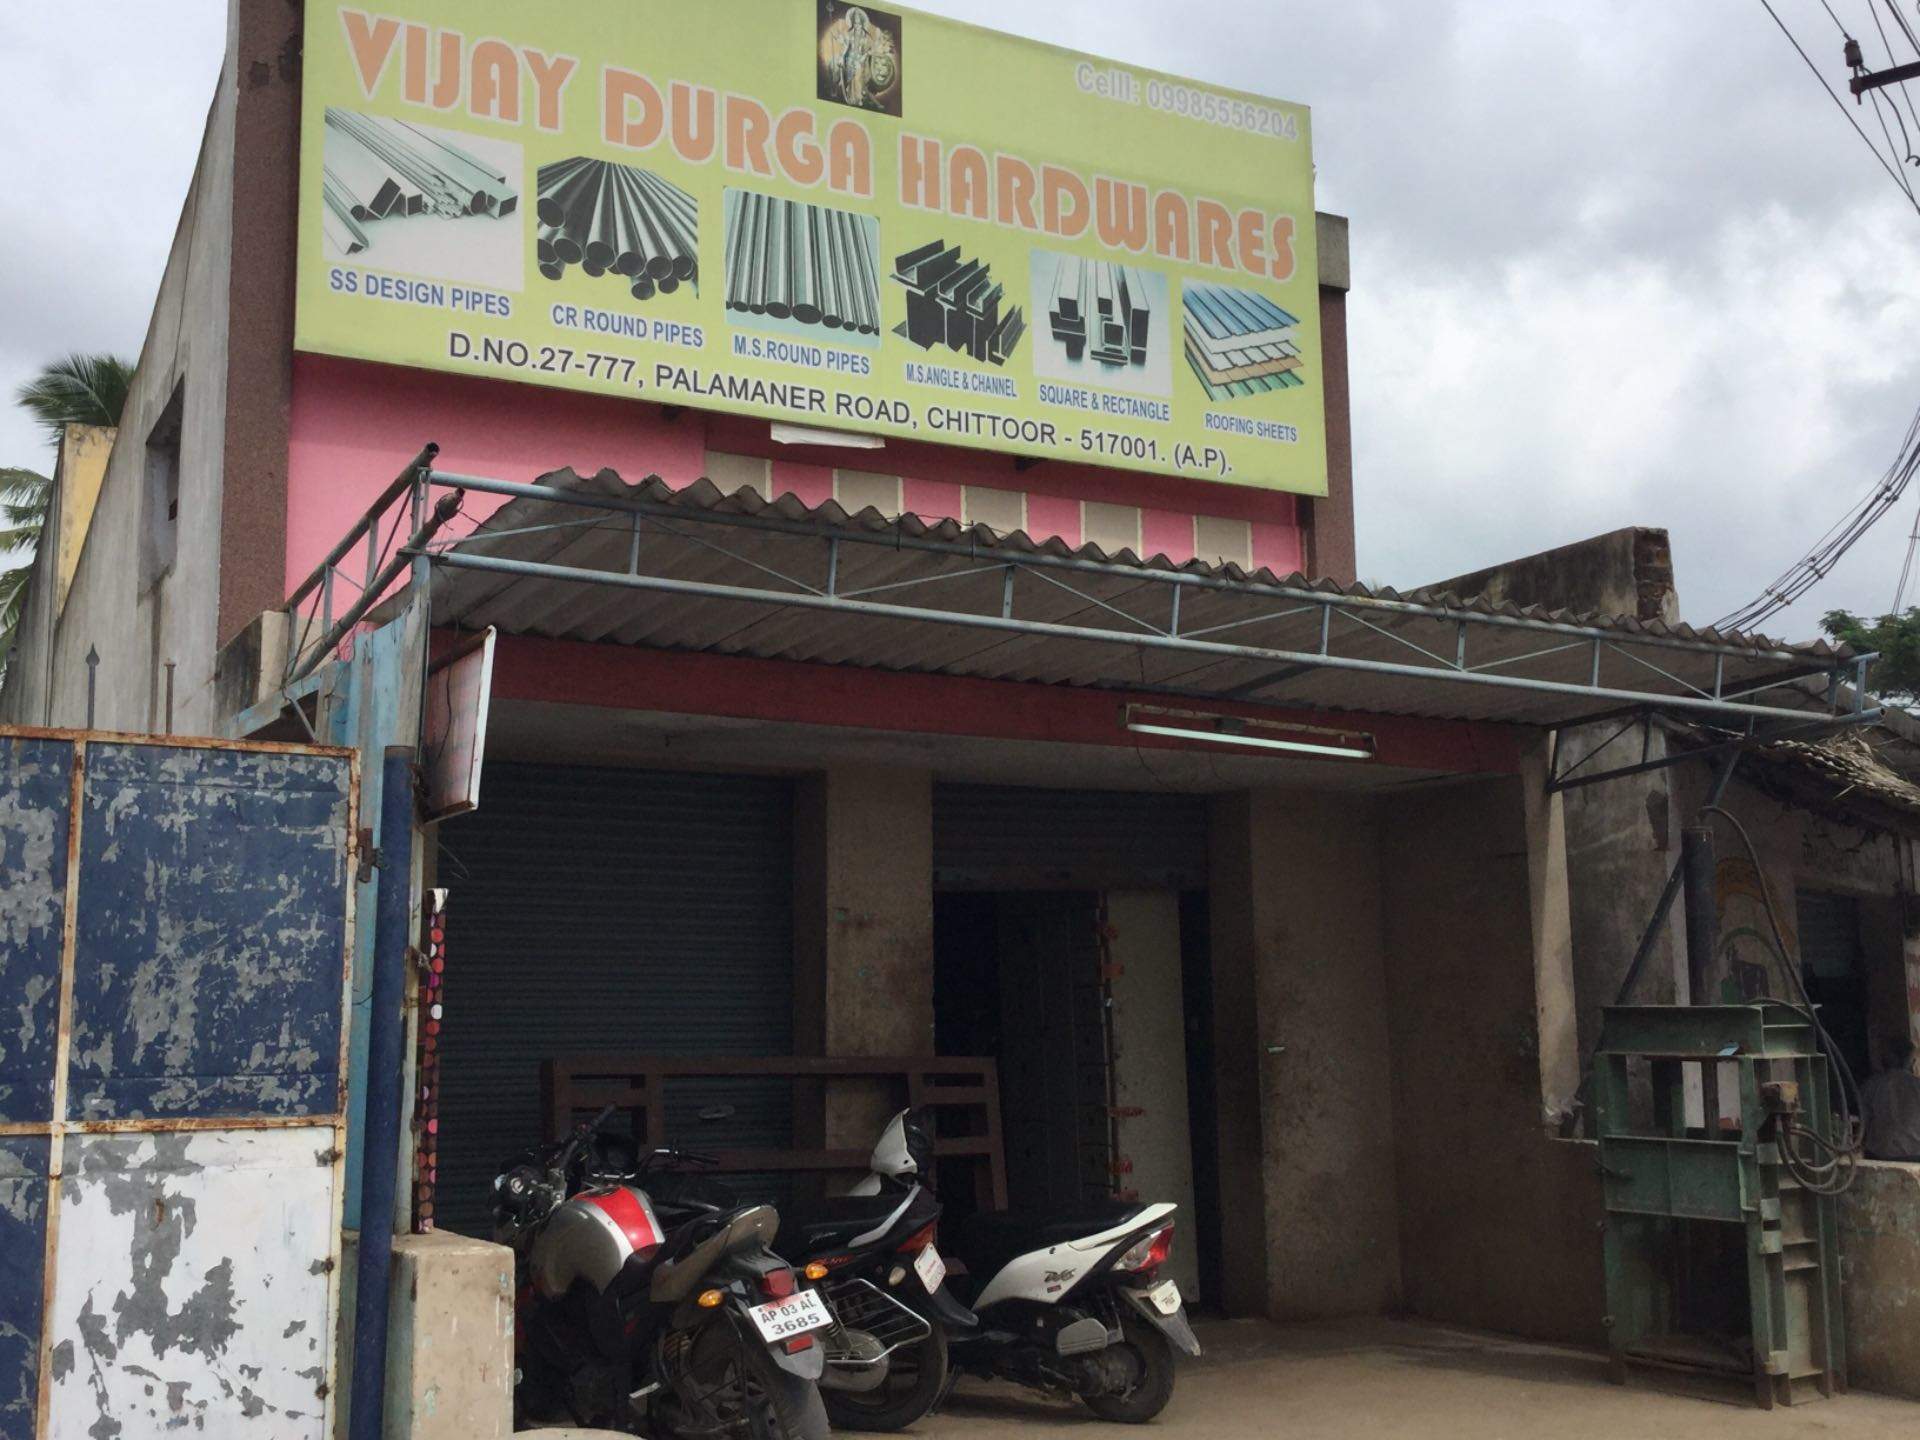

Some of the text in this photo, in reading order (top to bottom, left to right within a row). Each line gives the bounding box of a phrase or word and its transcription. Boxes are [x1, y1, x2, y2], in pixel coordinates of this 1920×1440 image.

[1147, 78, 1297, 140] 09985556204
[340, 8, 1297, 281] VIJAY DURGA HARDWARES
[330, 268, 510, 316] SS DESIGN PIPES
[552, 304, 704, 348] CR ROUND PIPES
[734, 334, 870, 375] M.S.ROUND PIPES
[906, 363, 1018, 398] M.S.ANGLE & CHANNEL
[450, 332, 645, 388] D.NO.27-777,
[655, 364, 826, 413] PALAMANER
[836, 392, 918, 430] ROAD,
[927, 406, 1057, 446] CHITTOOR
[1081, 429, 1166, 462] 517001.
[1174, 443, 1233, 476] (A.P).
[1039, 384, 1170, 421] SQUARE & RECTANGLE
[1205, 412, 1297, 442] ROOFING SHEETS
[761, 1310, 778, 1324] AP
[781, 1304, 798, 1317] 03
[772, 1313, 820, 1335] 3685
